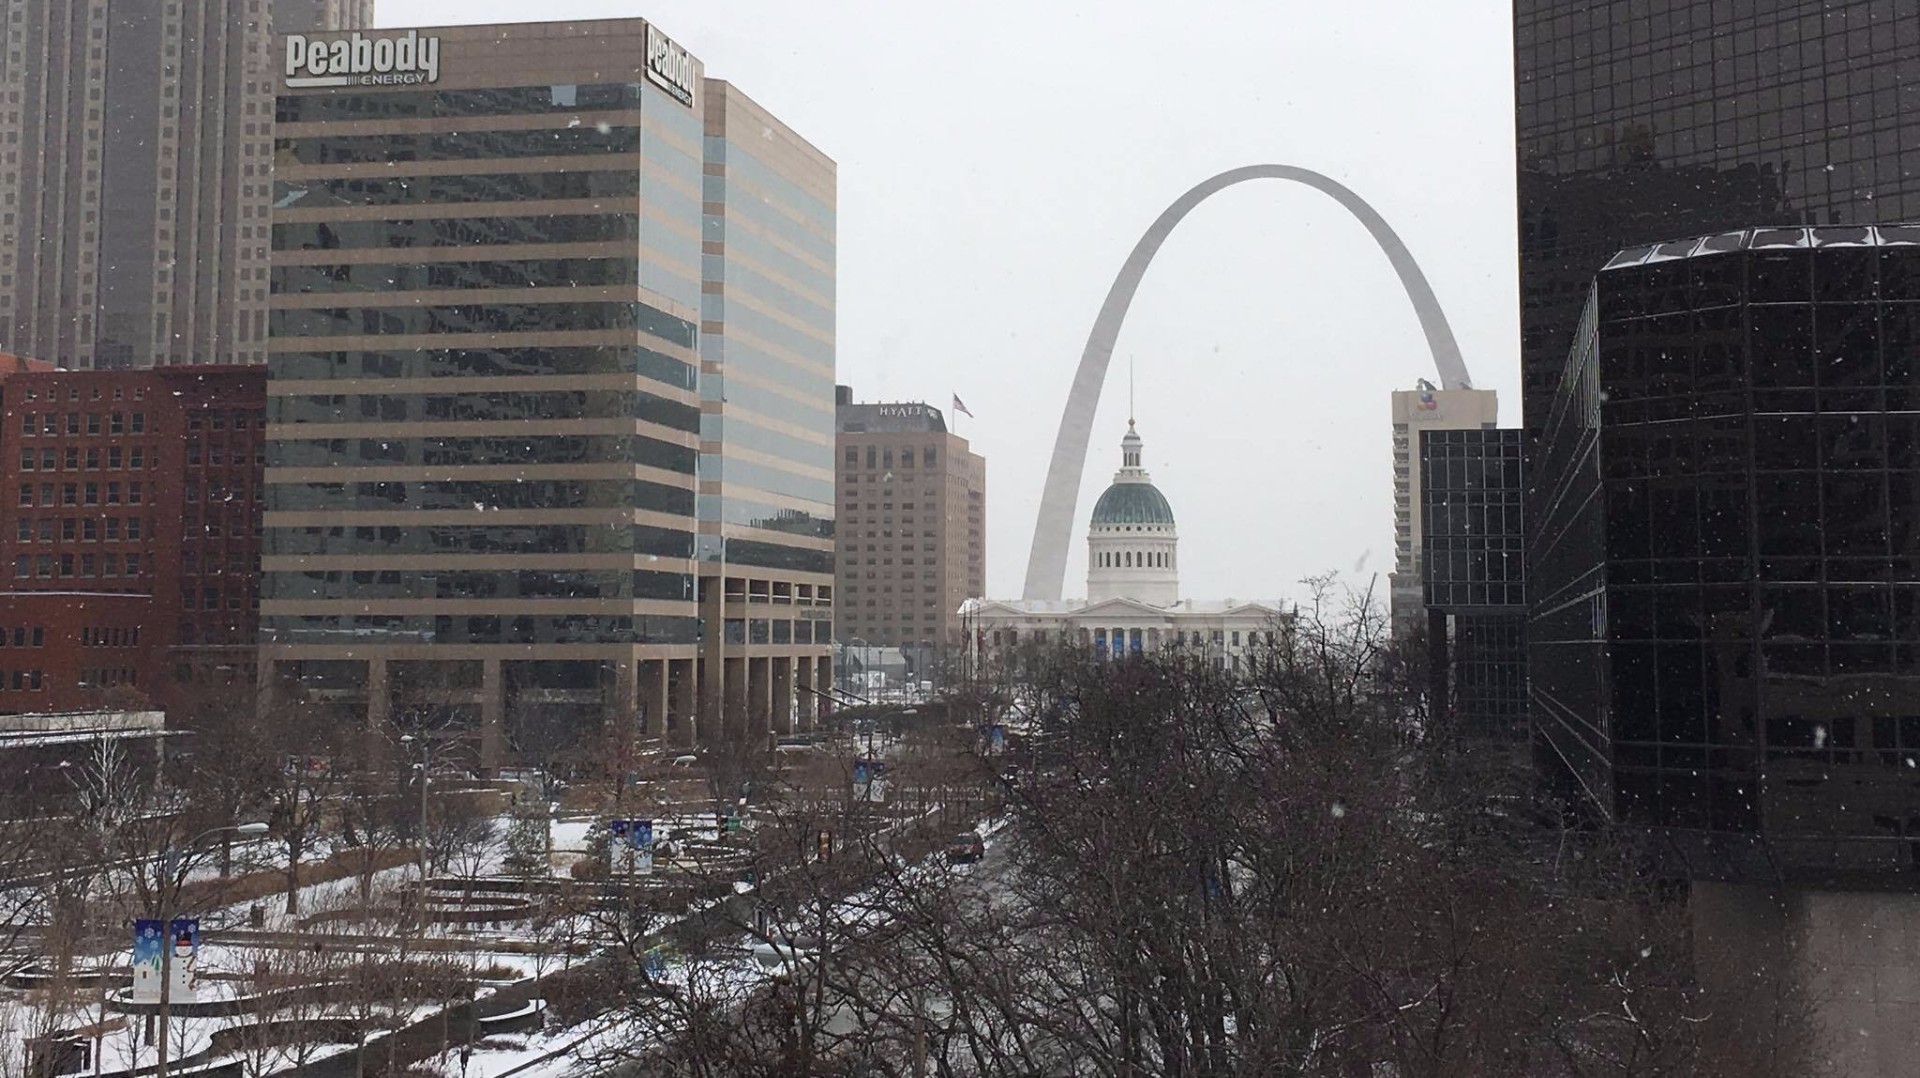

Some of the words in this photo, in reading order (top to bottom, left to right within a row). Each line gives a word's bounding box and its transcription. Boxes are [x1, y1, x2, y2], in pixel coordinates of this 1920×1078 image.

[286, 30, 439, 82] Peabody
[647, 23, 695, 108] Peabody
[360, 73, 426, 85] ENERGY
[880, 406, 922, 418] HYATT
